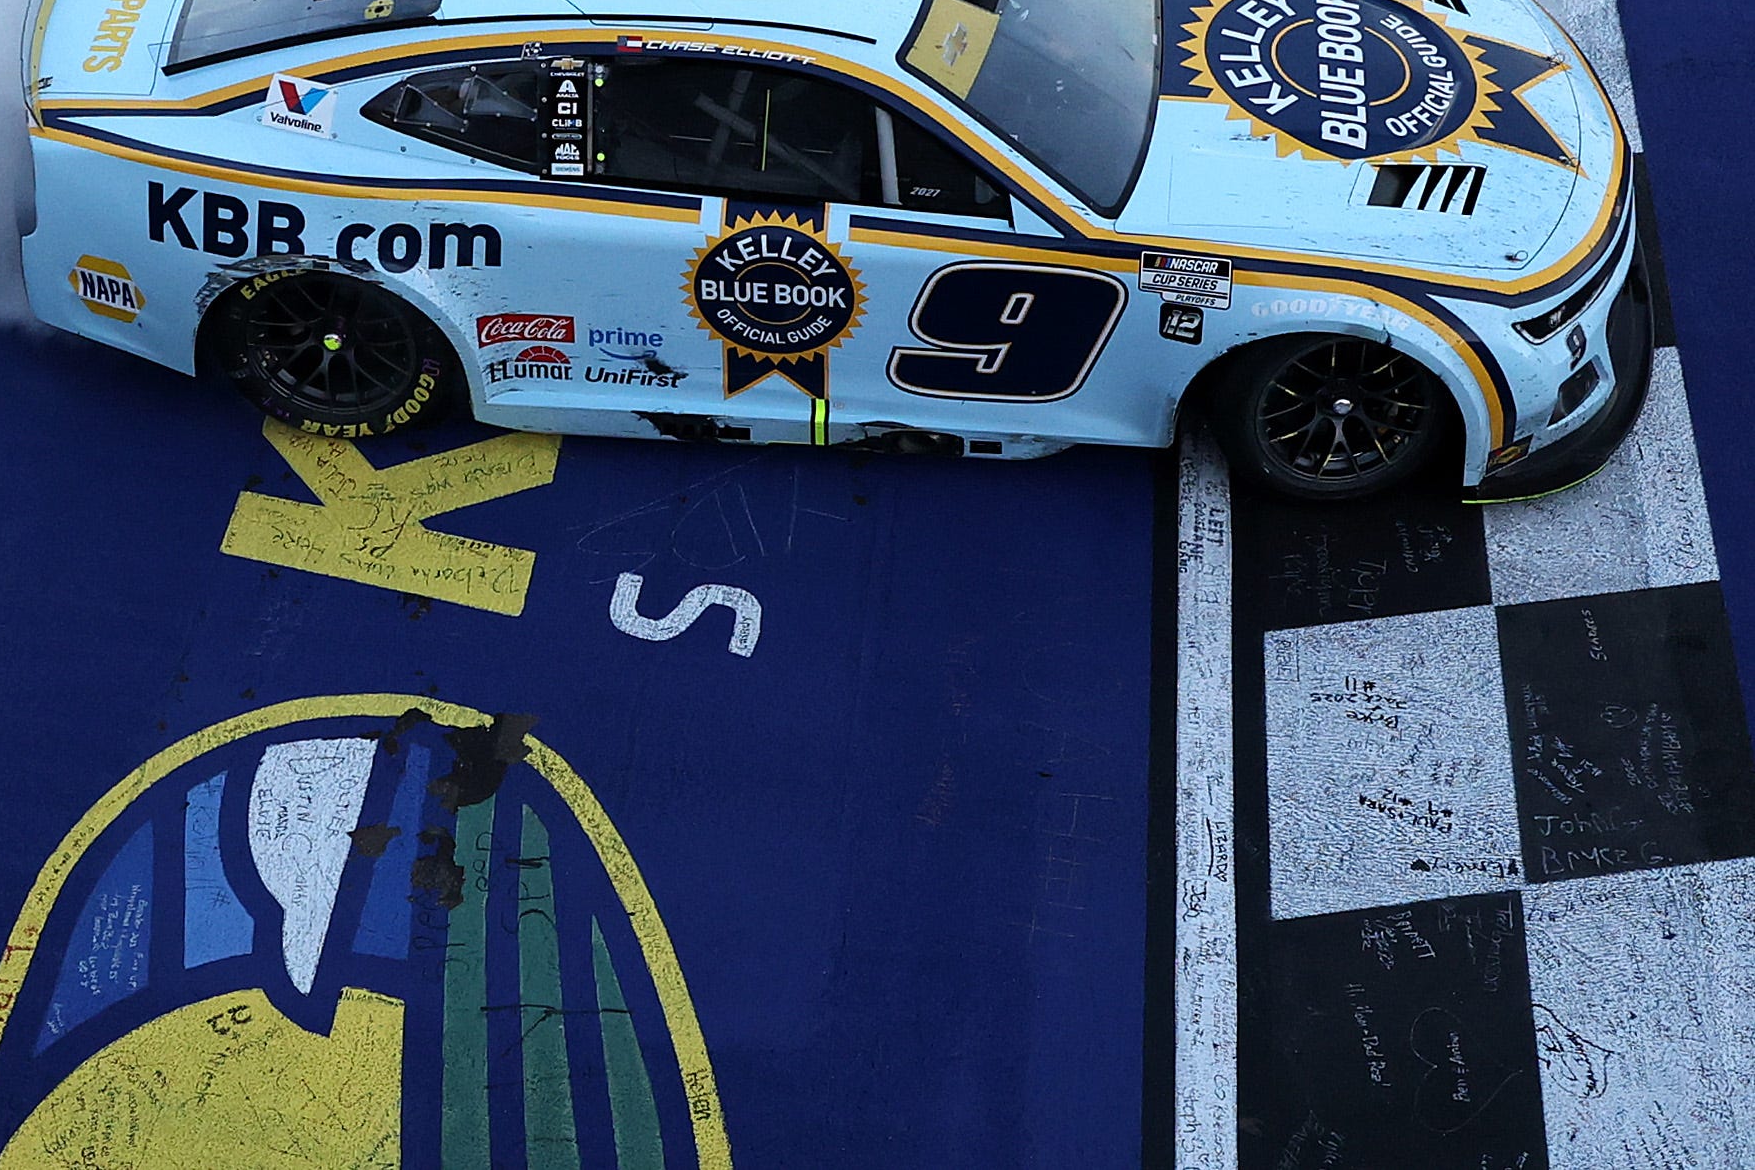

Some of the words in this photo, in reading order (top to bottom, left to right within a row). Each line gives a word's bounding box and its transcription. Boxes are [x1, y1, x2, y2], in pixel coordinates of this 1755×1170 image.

[646, 40, 718, 52] CHASE
[721, 45, 817, 65] ELLIOTT
[1379, 12, 1446, 68] GUIDE
[1319, 63, 1369, 151] BLUE
[1384, 68, 1455, 139] OFFICIAL
[271, 112, 322, 132] Valvoline
[147, 180, 502, 275] KBB.com
[715, 234, 837, 277] KELLEY
[1169, 258, 1219, 274] NASCAR
[79, 271, 138, 309] NAPA
[700, 279, 768, 304] BLUE
[775, 284, 846, 308] BOOK
[1152, 273, 1176, 285] CUP
[1176, 276, 1218, 291] SERIES
[1175, 294, 1216, 306] PLAYOFFS
[481, 317, 570, 343] Coca-Cola
[589, 327, 664, 347] prime
[717, 308, 786, 345] OFFICIAL
[787, 315, 832, 343] GUIDE
[885, 260, 1129, 404] 9
[585, 366, 681, 388] UniFirst
[1207, 508, 1224, 548] LEFT
[1309, 692, 1358, 704] 2025
